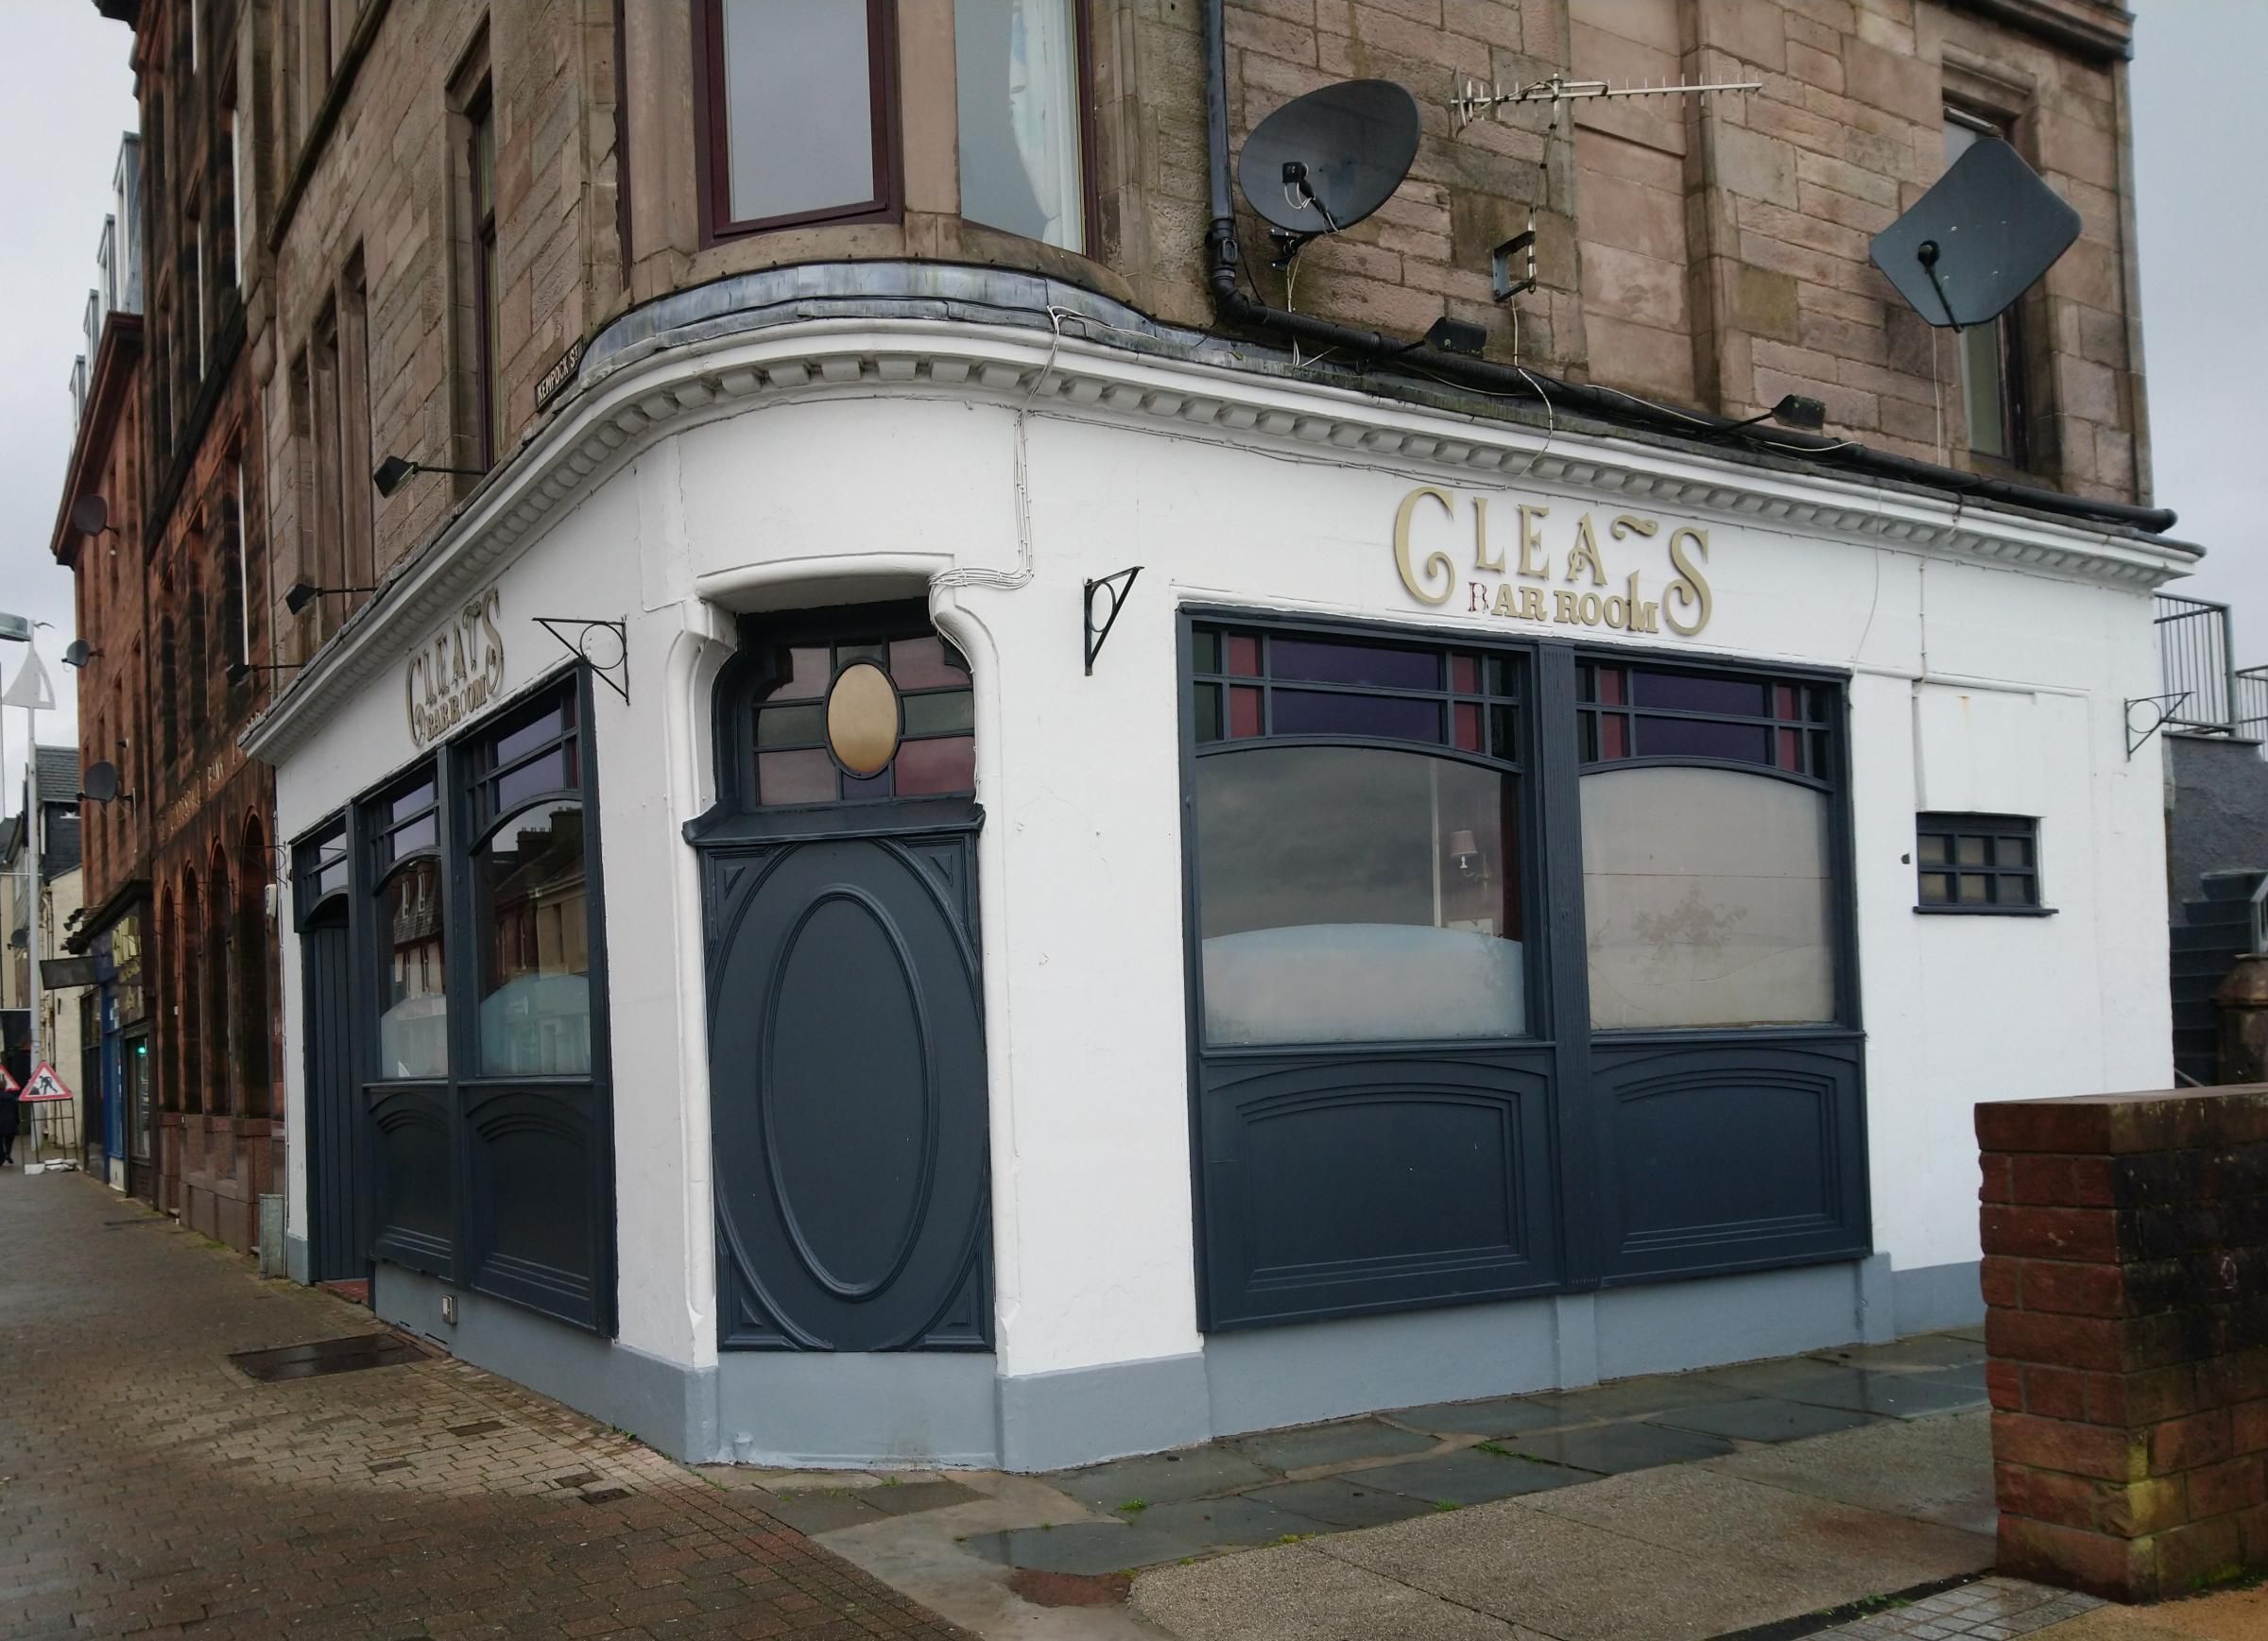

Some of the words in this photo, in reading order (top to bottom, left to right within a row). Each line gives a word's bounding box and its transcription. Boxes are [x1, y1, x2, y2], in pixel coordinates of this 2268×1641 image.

[537, 356, 569, 404] KEMPOCK
[1554, 589, 1659, 634] ROOM
[405, 586, 505, 747] CLEATS
